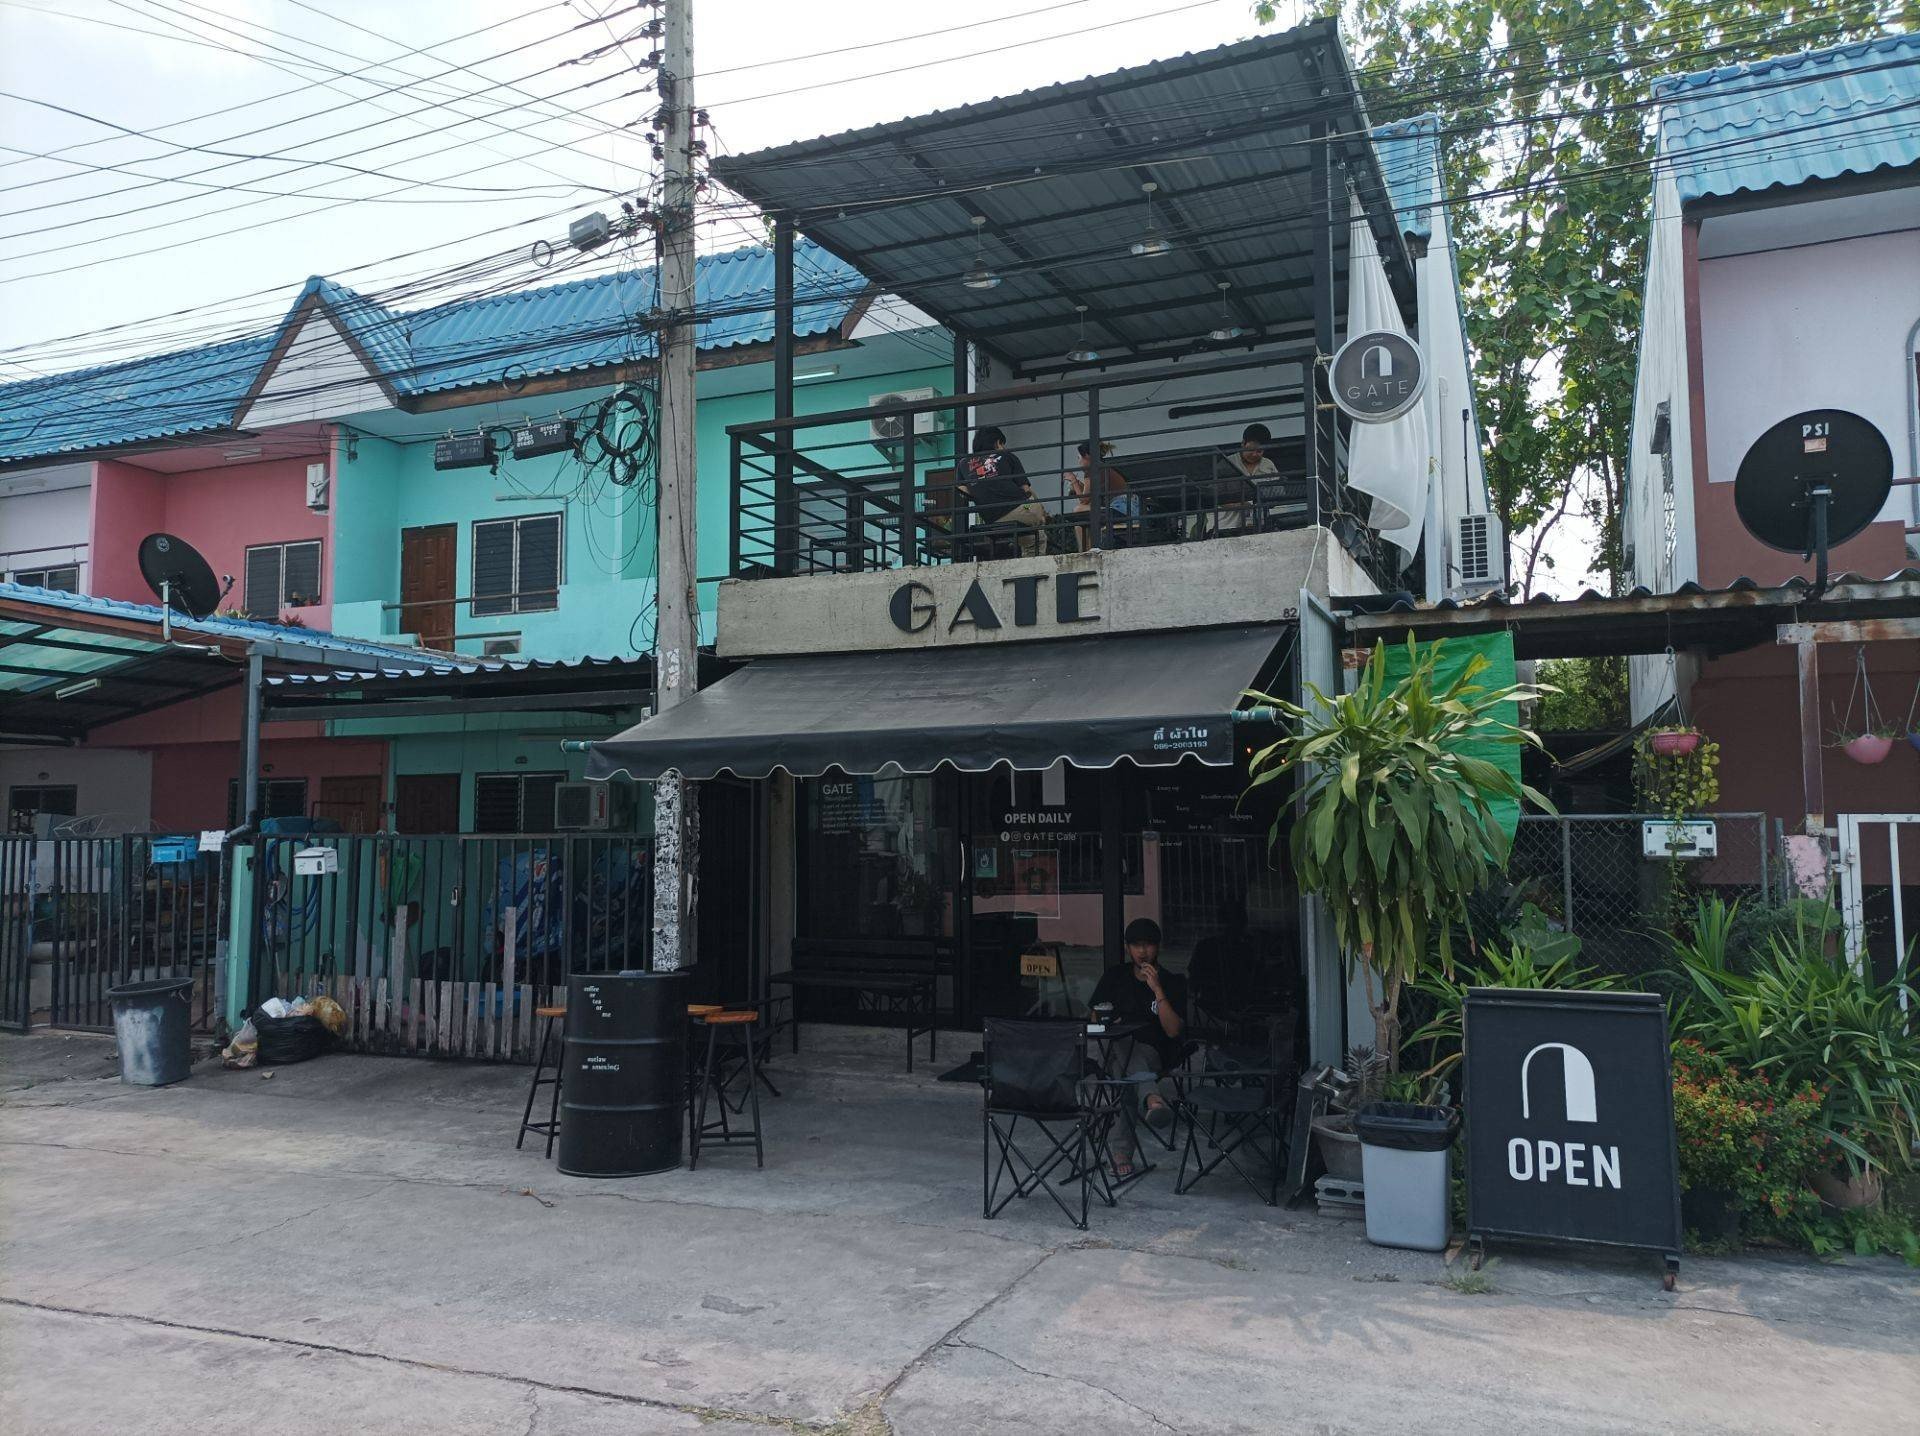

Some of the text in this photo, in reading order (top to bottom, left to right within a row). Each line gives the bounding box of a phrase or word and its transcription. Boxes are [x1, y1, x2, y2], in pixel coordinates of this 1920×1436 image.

[1347, 380, 1409, 399] GATE
[1802, 422, 1829, 437] PSI
[889, 570, 1101, 635] GATE
[1283, 607, 1297, 618] 82
[822, 783, 853, 795] GATE
[1004, 812, 1072, 824] OPEN DAILY
[1023, 832, 1055, 841] GATE
[1026, 963, 1051, 974] OPEN
[1508, 1137, 1622, 1189] OPEN
